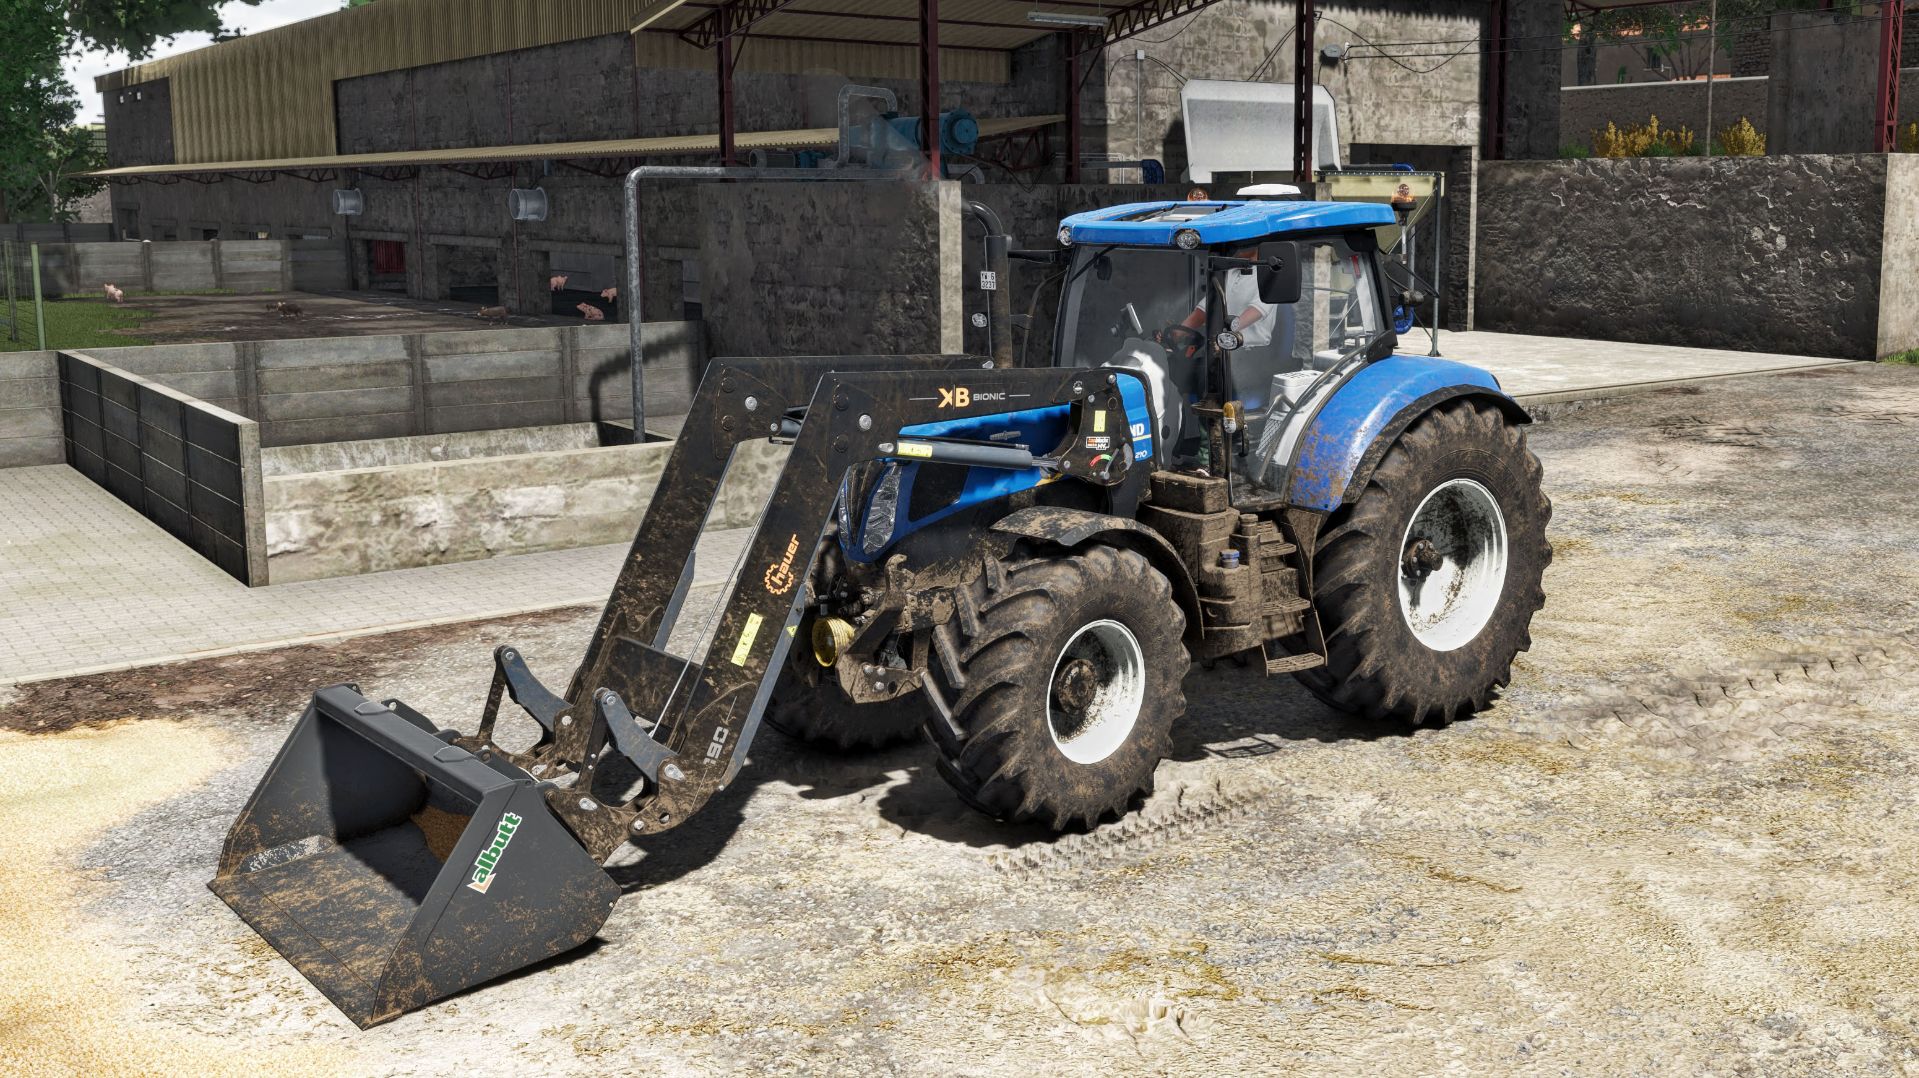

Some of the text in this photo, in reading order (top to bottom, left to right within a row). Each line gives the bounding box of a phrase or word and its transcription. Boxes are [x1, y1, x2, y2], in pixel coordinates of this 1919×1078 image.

[938, 387, 1006, 408] XB BIONIC
[771, 533, 799, 586] hauer
[472, 812, 522, 884] albutt
